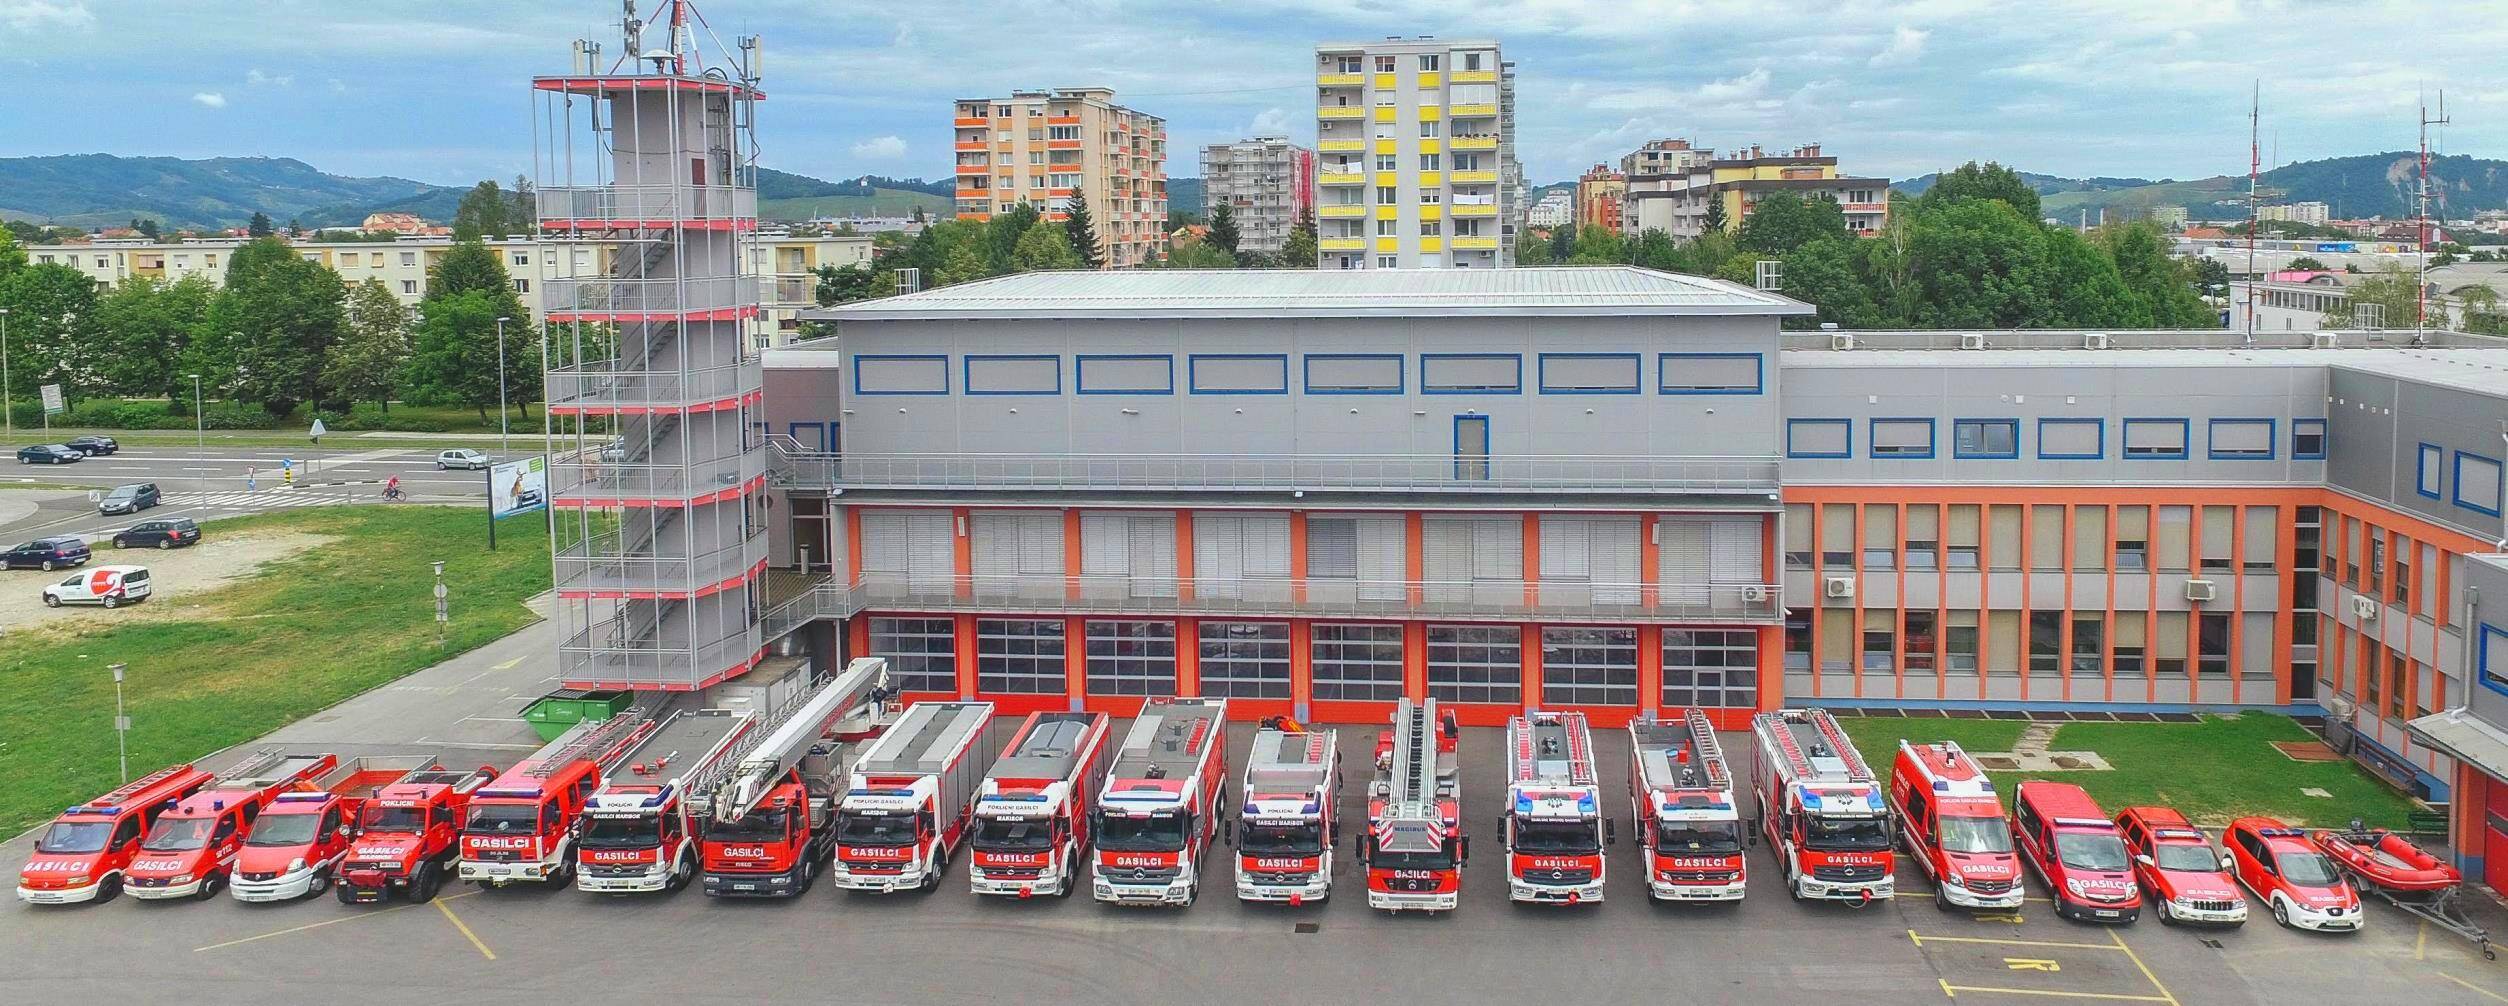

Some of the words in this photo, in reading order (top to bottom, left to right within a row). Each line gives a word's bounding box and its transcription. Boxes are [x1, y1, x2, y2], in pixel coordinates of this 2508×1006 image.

[469, 838, 529, 848] GASILCI
[595, 852, 640, 860] GASILCI
[724, 847, 764, 857] GASILCI
[850, 848, 899, 857] GASILCI
[986, 854, 1036, 863] GASILCI
[1117, 857, 1162, 866] GASILCI
[1674, 858, 1728, 867] GASILCI
[23, 862, 90, 872] GASILCI
[133, 861, 183, 871] GASILCI
[1258, 859, 1303, 868] GASILCI
[1962, 864, 2010, 874] GASILCI
[1394, 870, 1430, 879] GASILCI
[2081, 879, 2128, 890] GASILCI
